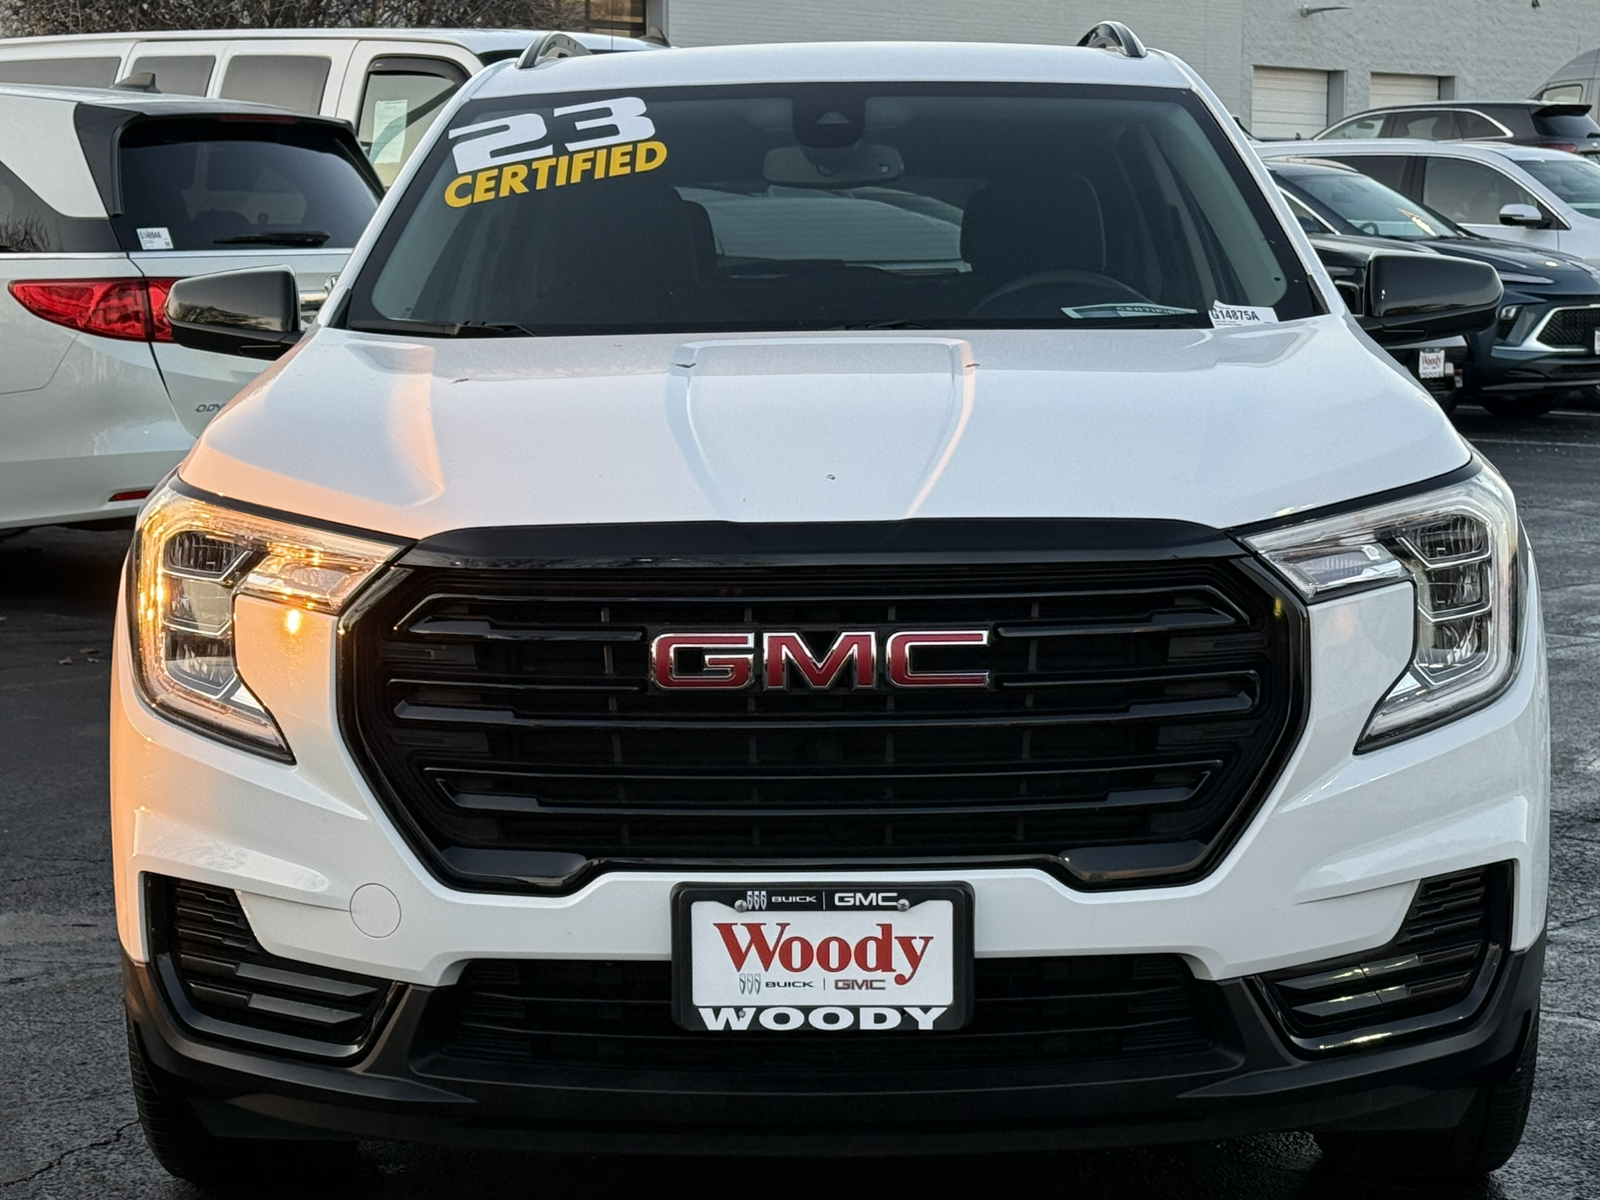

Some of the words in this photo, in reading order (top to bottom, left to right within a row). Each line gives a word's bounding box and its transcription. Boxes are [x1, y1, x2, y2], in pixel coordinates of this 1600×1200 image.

[448, 97, 656, 174] 23
[444, 141, 668, 208] CERTIFIED
[1211, 308, 1260, 321] G14875A
[651, 630, 990, 690] GMC
[771, 895, 817, 903] BUICK
[834, 892, 898, 906] GMC
[713, 922, 934, 986] Woody
[765, 980, 814, 988] BUICK
[834, 979, 886, 990] GMC
[698, 1007, 948, 1031] WOODY
